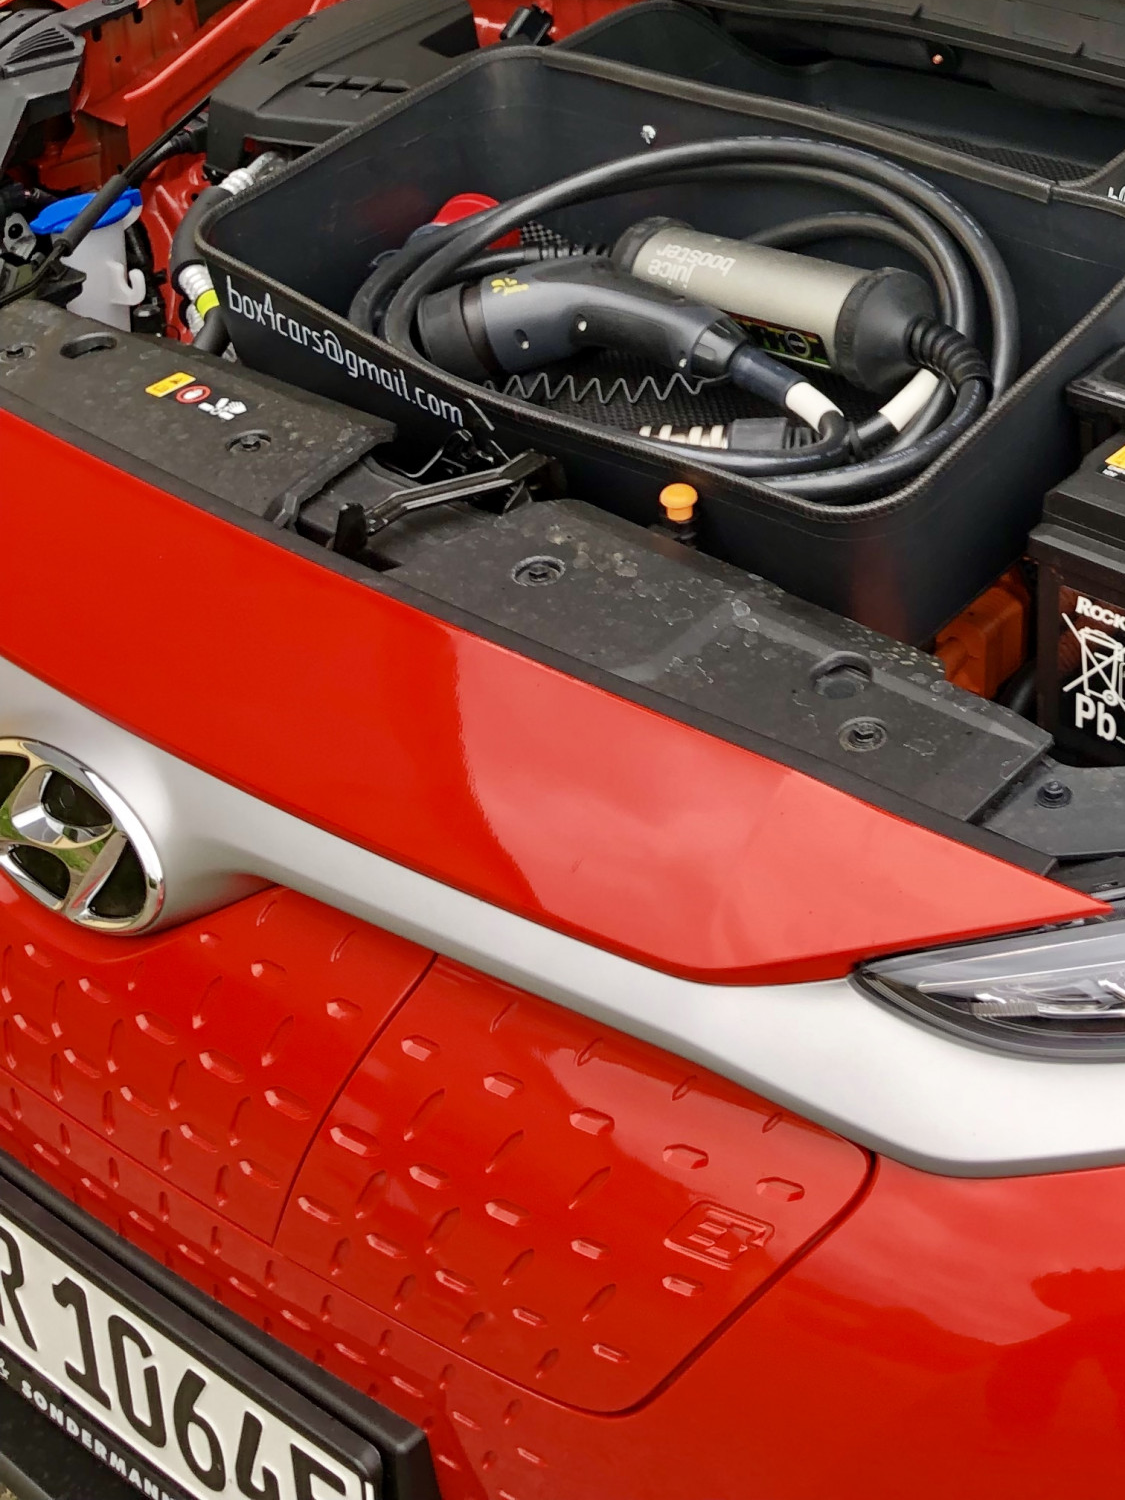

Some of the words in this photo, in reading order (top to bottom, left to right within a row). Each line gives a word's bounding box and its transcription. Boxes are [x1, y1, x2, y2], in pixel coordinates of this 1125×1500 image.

[647, 258, 697, 289] juice
[655, 243, 737, 277] booster
[226, 275, 464, 427] box4cars@gmail.com
[1075, 692, 1117, 741] Pb
[21, 1380, 176, 1500] SONDERMAN
